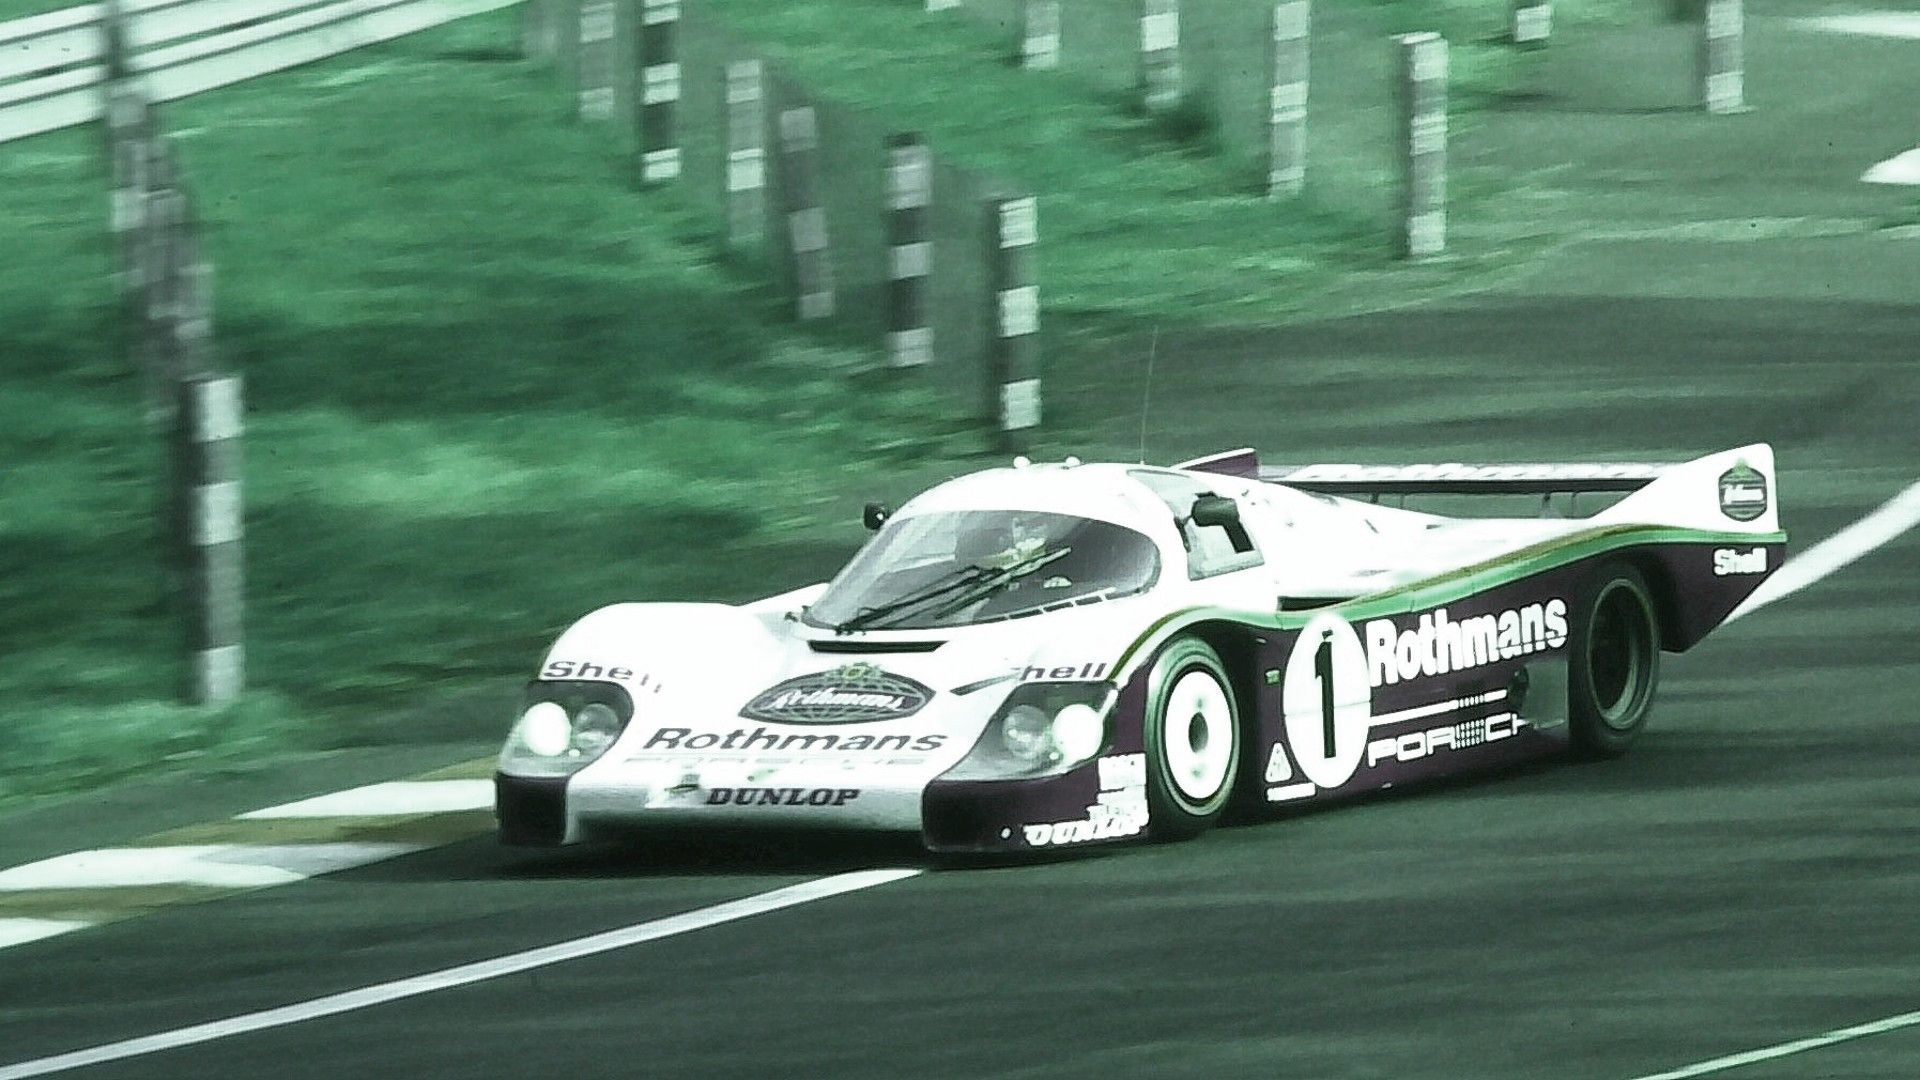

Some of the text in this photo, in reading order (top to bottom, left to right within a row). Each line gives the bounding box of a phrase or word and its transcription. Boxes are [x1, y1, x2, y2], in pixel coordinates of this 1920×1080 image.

[1366, 599, 1568, 688] Rothmans
[1011, 662, 1108, 682] hell
[1314, 640, 1337, 760] 1
[642, 727, 948, 752] Rothmans
[1367, 712, 1531, 768] PORSCH
[706, 787, 862, 807] DUNLOP
